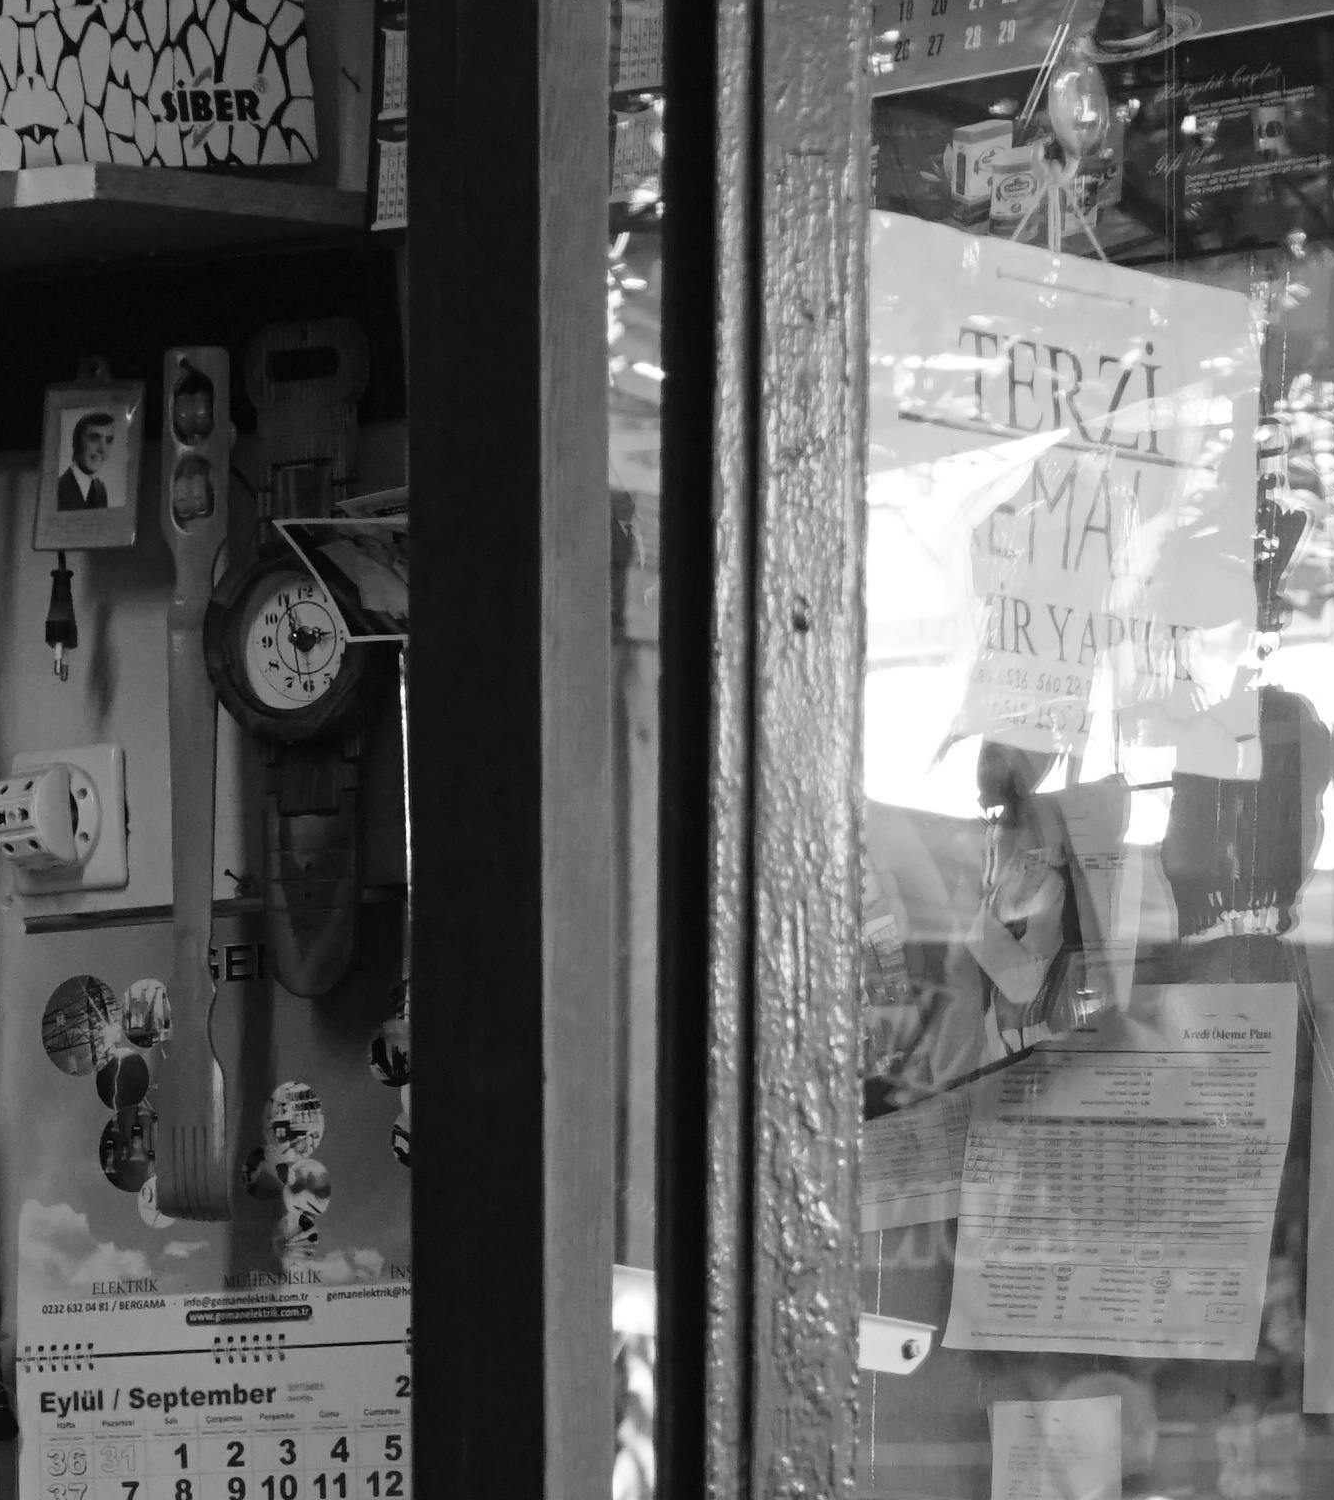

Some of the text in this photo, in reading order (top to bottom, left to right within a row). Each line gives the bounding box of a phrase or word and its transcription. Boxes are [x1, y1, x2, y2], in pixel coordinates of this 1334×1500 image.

[927, 33, 945, 57] 27
[160, 78, 261, 123] SİBER
[958, 326, 1164, 455] TERZİ
[265, 613, 278, 625] 10
[262, 635, 273, 648] 9
[92, 1270, 323, 1295] ELEKTRİK MÜHENDİSLİK
[42, 1304, 64, 1315] 0232
[67, 1303, 83, 1314] 632
[86, 1302, 96, 1313] 04
[99, 1301, 108, 1312] 81
[119, 1299, 166, 1311] BERGAMA
[184, 1291, 309, 1309] info@gemanelektrik.com.tr
[189, 1308, 311, 1323] www.gemanelektrik.com.tr
[40, 1383, 277, 1418] Eylül September
[47, 1448, 87, 1477] 36
[175, 1444, 187, 1469] 1
[227, 1442, 245, 1467] 2
[280, 1439, 296, 1465] 3
[331, 1437, 349, 1462] 4
[385, 1435, 402, 1461] 5
[262, 1475, 297, 1500] 10
[314, 1473, 346, 1499] 11
[367, 1471, 403, 1497] 12
